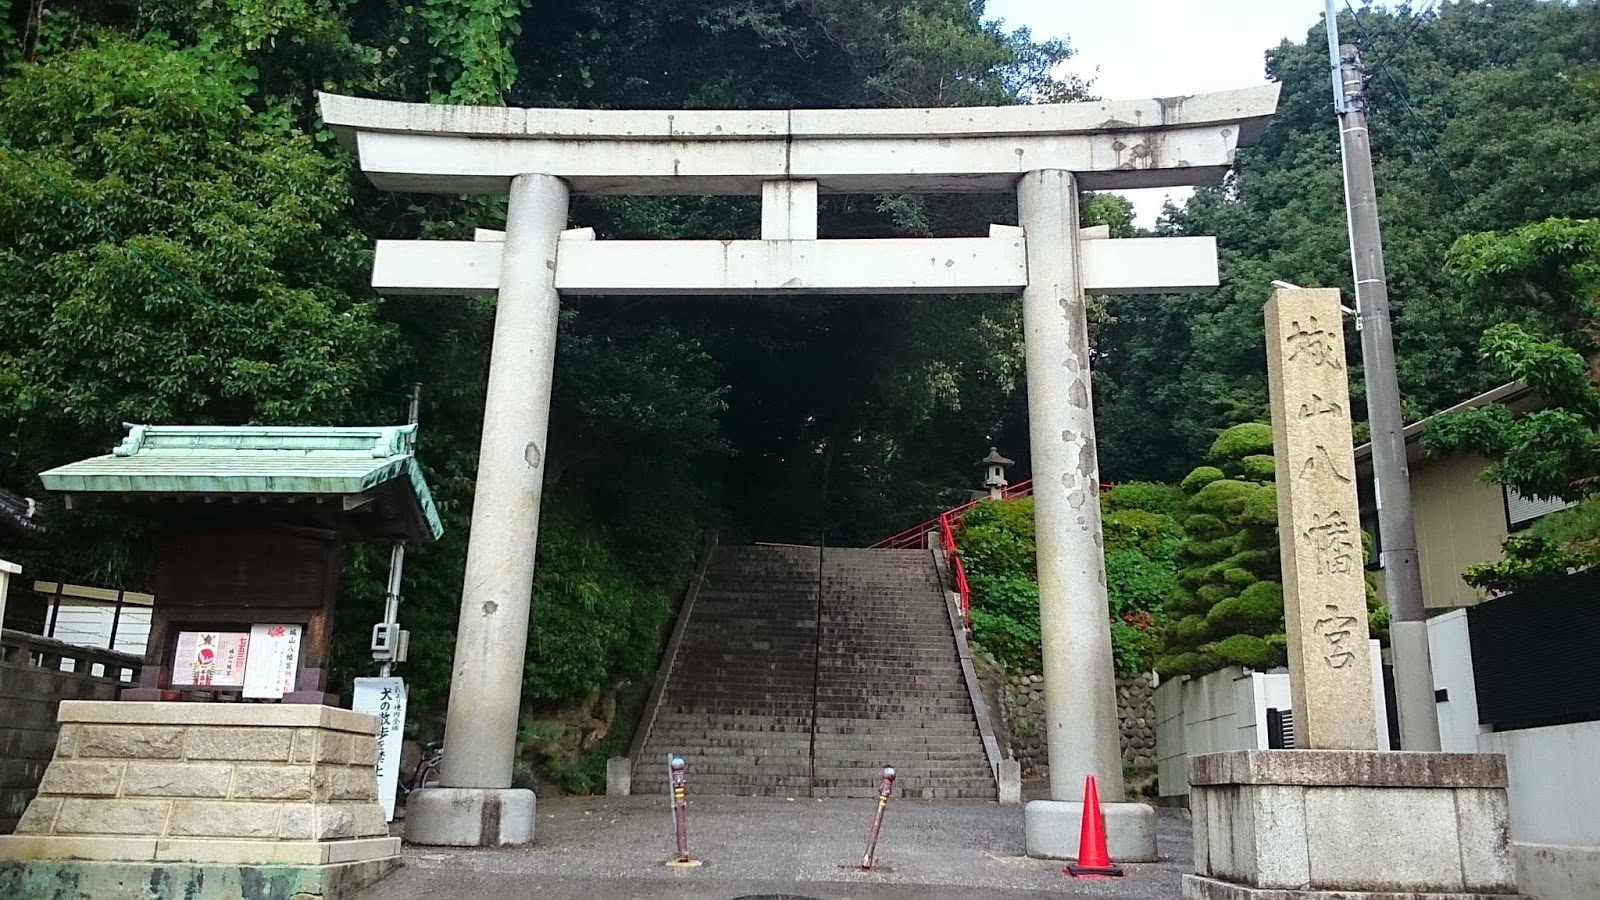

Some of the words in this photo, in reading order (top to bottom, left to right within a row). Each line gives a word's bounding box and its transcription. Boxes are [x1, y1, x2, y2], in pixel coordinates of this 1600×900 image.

[1287, 316, 1357, 670] 城山八幡宮
